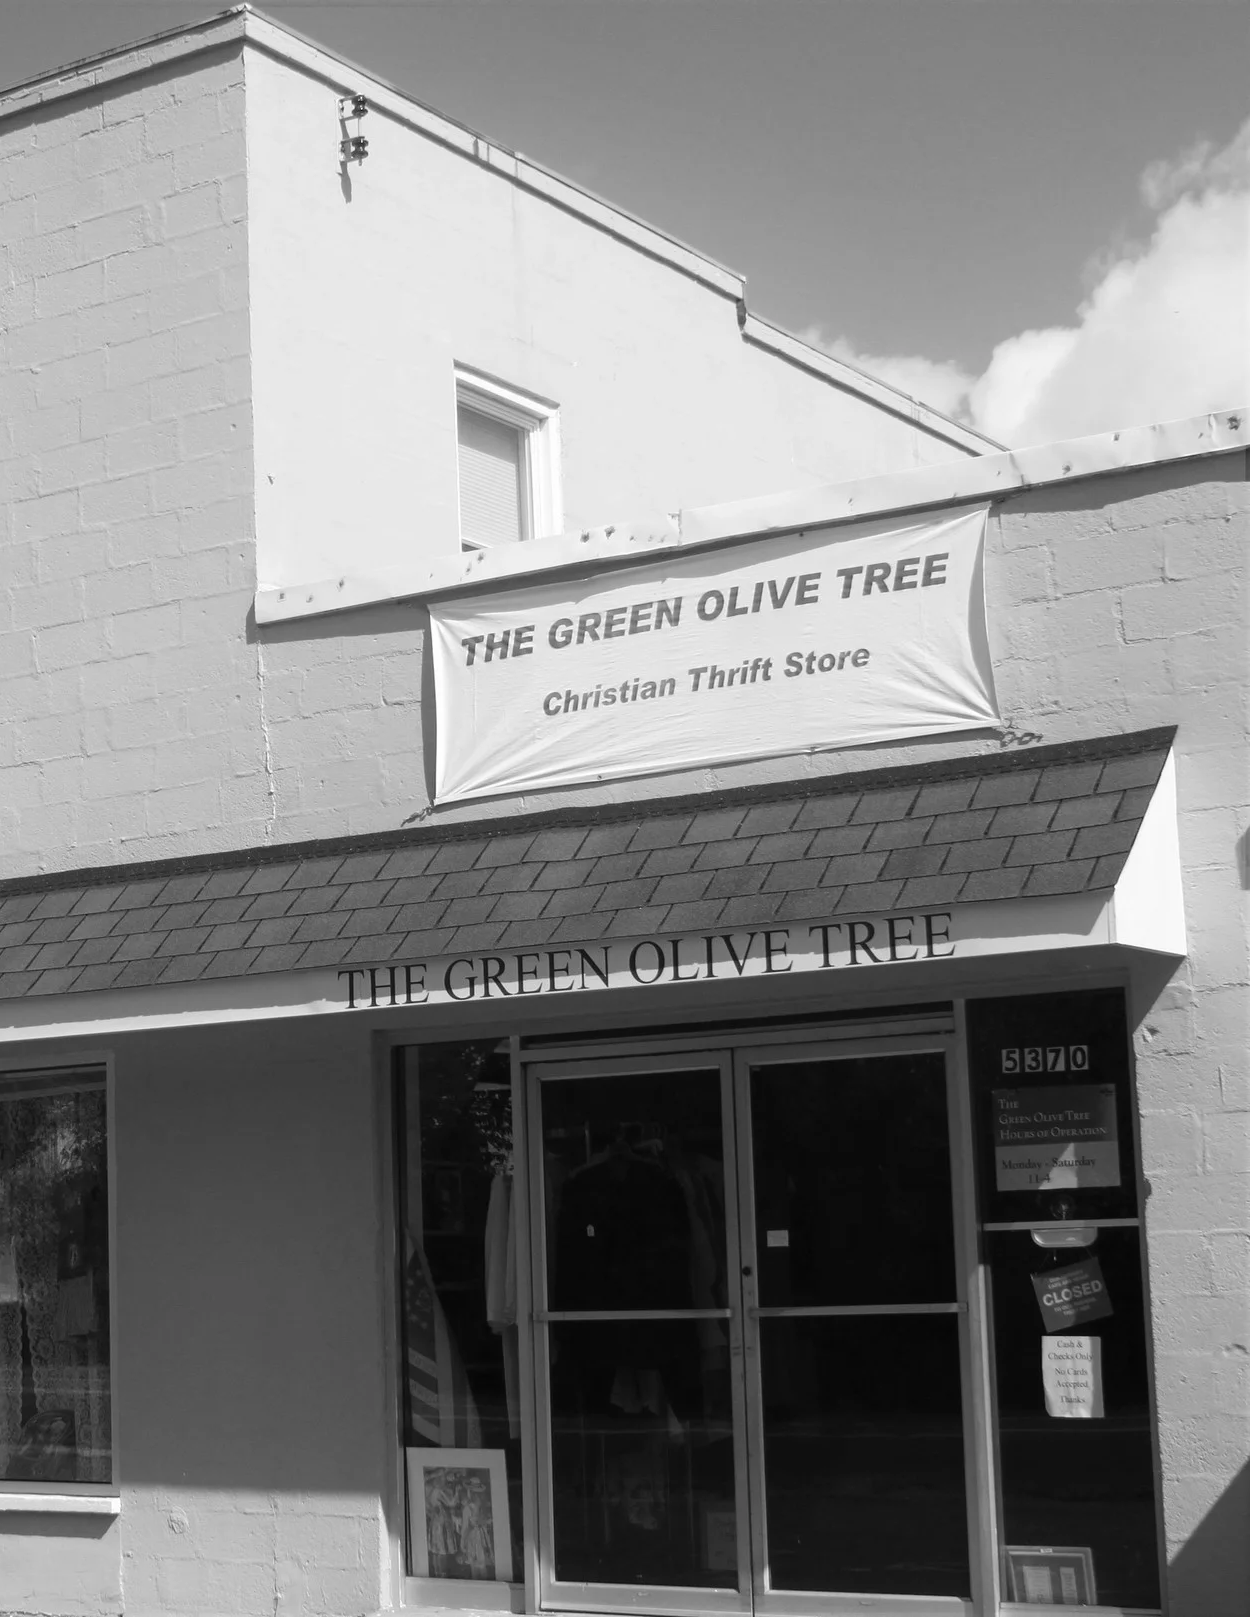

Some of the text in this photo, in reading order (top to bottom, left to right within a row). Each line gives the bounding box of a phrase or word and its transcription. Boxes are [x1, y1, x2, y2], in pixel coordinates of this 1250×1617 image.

[461, 552, 949, 667] THE GREEN OLIVE TREE
[543, 648, 870, 716] Christian Thrift Store
[337, 912, 956, 1009] THE GREEN OLIVE TREE
[1003, 1047, 1087, 1072] 5370
[1002, 1159, 1042, 1170] Monday
[1051, 1156, 1096, 1168] Saturday
[1042, 1279, 1102, 1307] CLOSED
[1056, 1340, 1083, 1348] Cash &
[1047, 1352, 1094, 1362] Checks Only
[1055, 1367, 1088, 1376] No Cards
[1056, 1380, 1089, 1389] Accepted
[1060, 1395, 1086, 1403] Thanks
